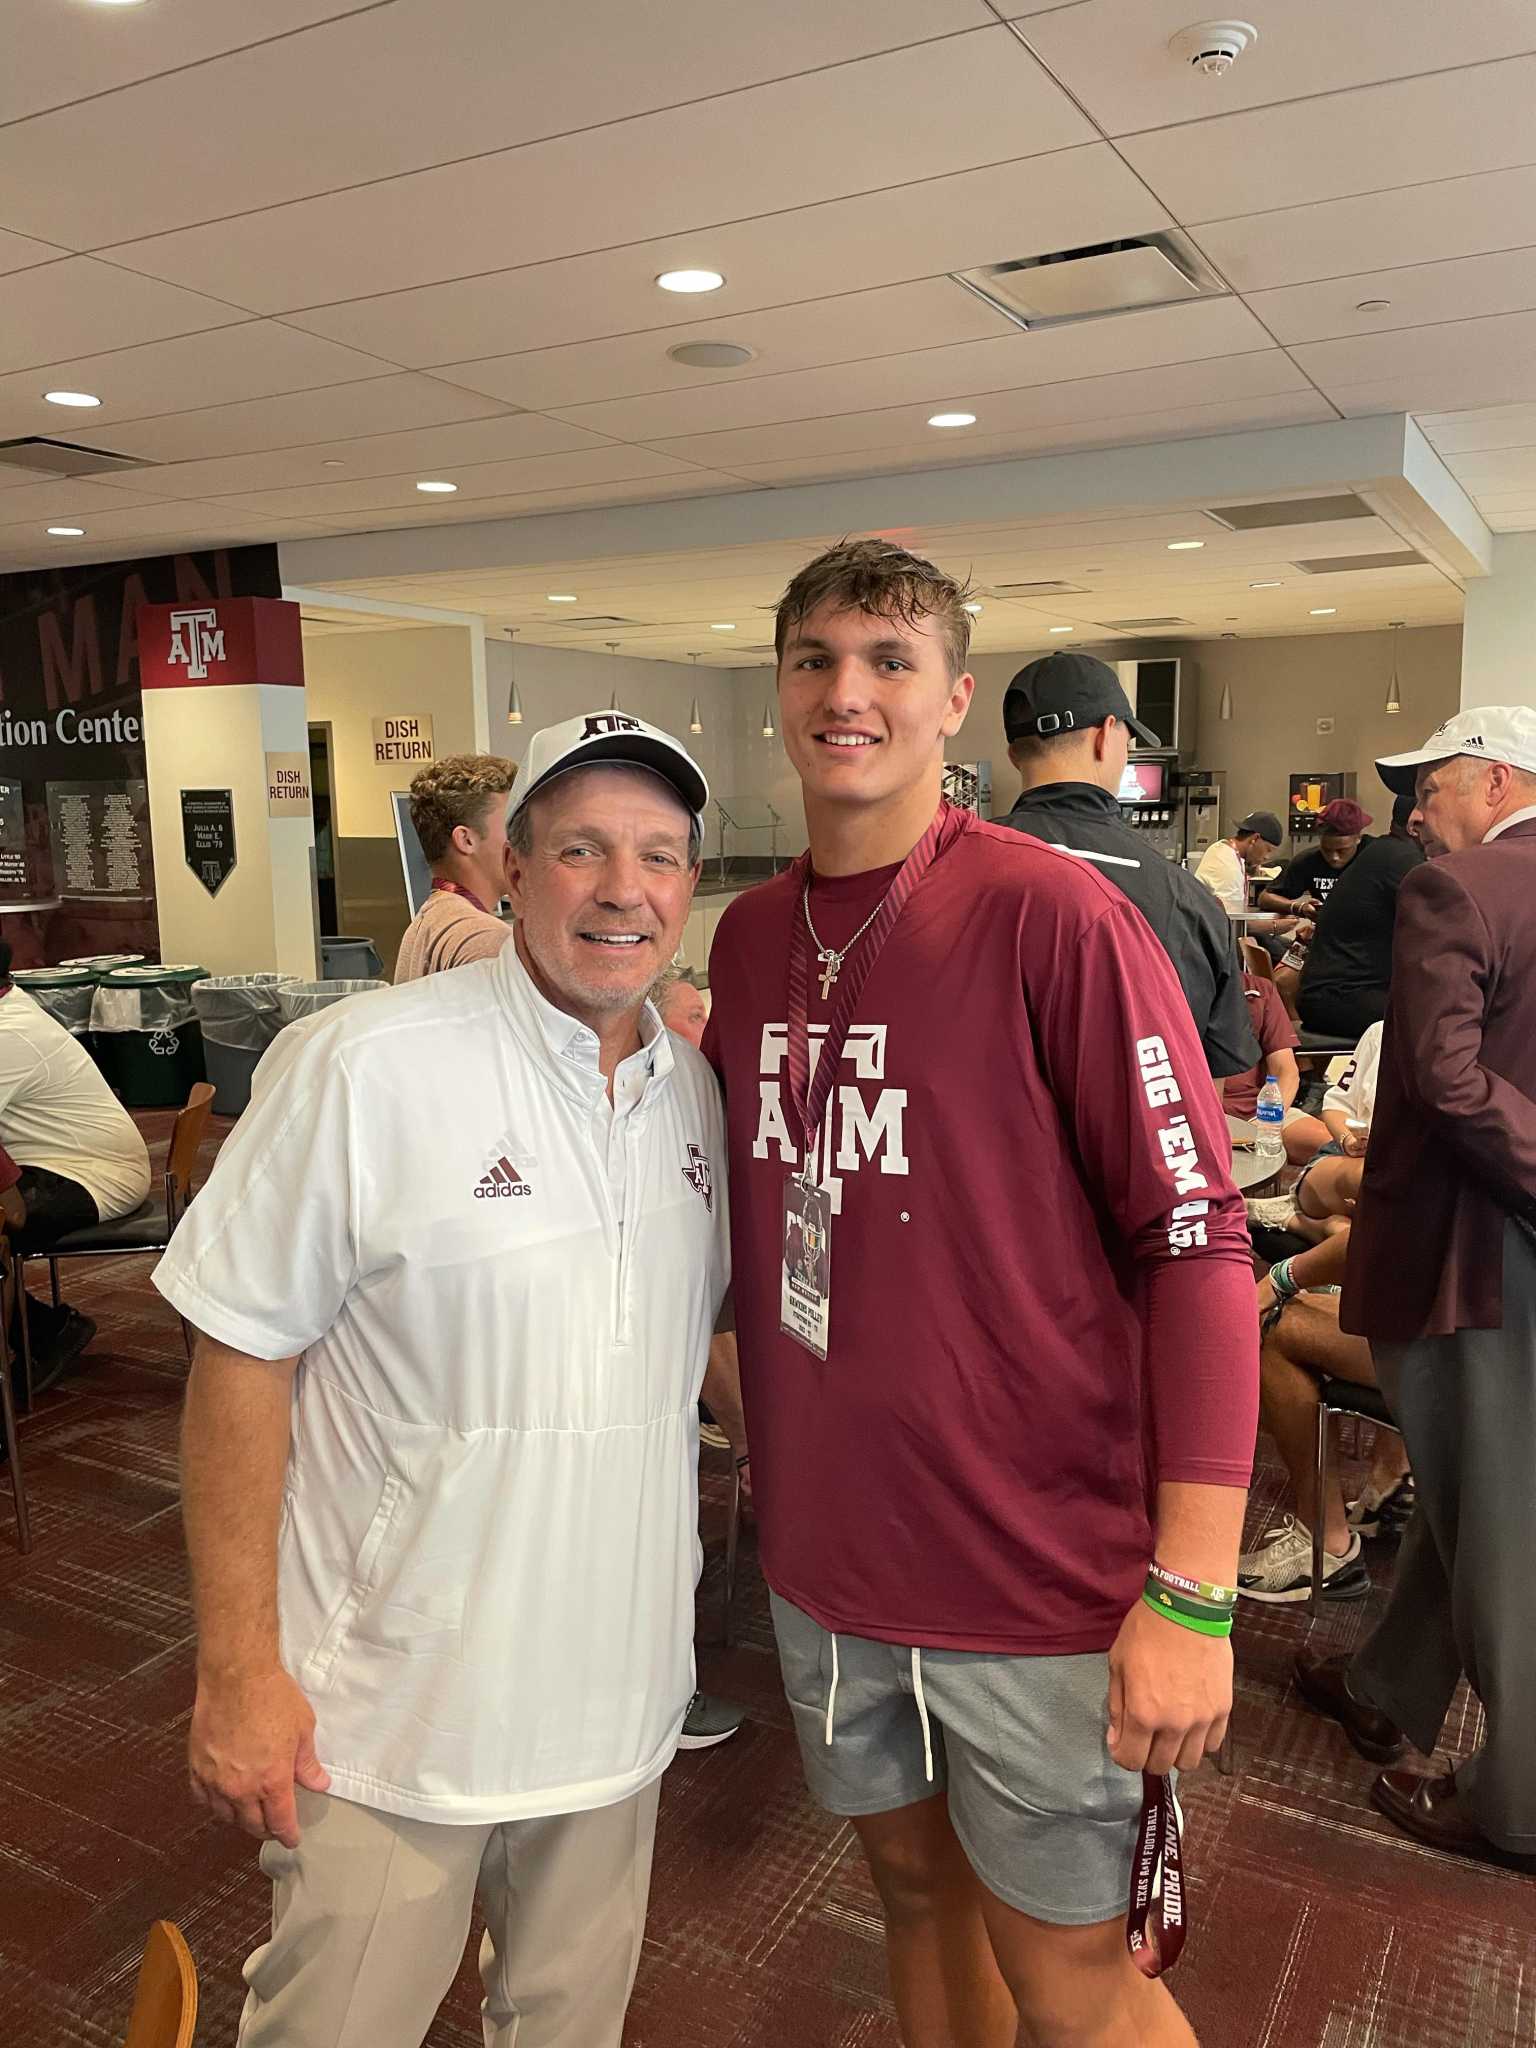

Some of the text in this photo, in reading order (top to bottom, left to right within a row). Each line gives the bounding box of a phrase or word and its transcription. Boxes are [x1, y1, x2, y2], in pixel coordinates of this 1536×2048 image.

[385, 720, 419, 738] DISH
[375, 741, 432, 760] RETURN
[277, 771, 300, 783] DISH
[270, 786, 309, 799] RETURN
[1314, 877, 1339, 890] TEX
[1136, 1035, 1183, 1109] GIG
[1157, 1114, 1209, 1196] 'EM
[474, 1182, 532, 1198] adidas
[1159, 1570, 1200, 1593] FOOTBALL
[1136, 1879, 1148, 1909] TEXAS
[1143, 1805, 1158, 1854] FOOTBALL
[1162, 1866, 1182, 1930] PRIDE.
